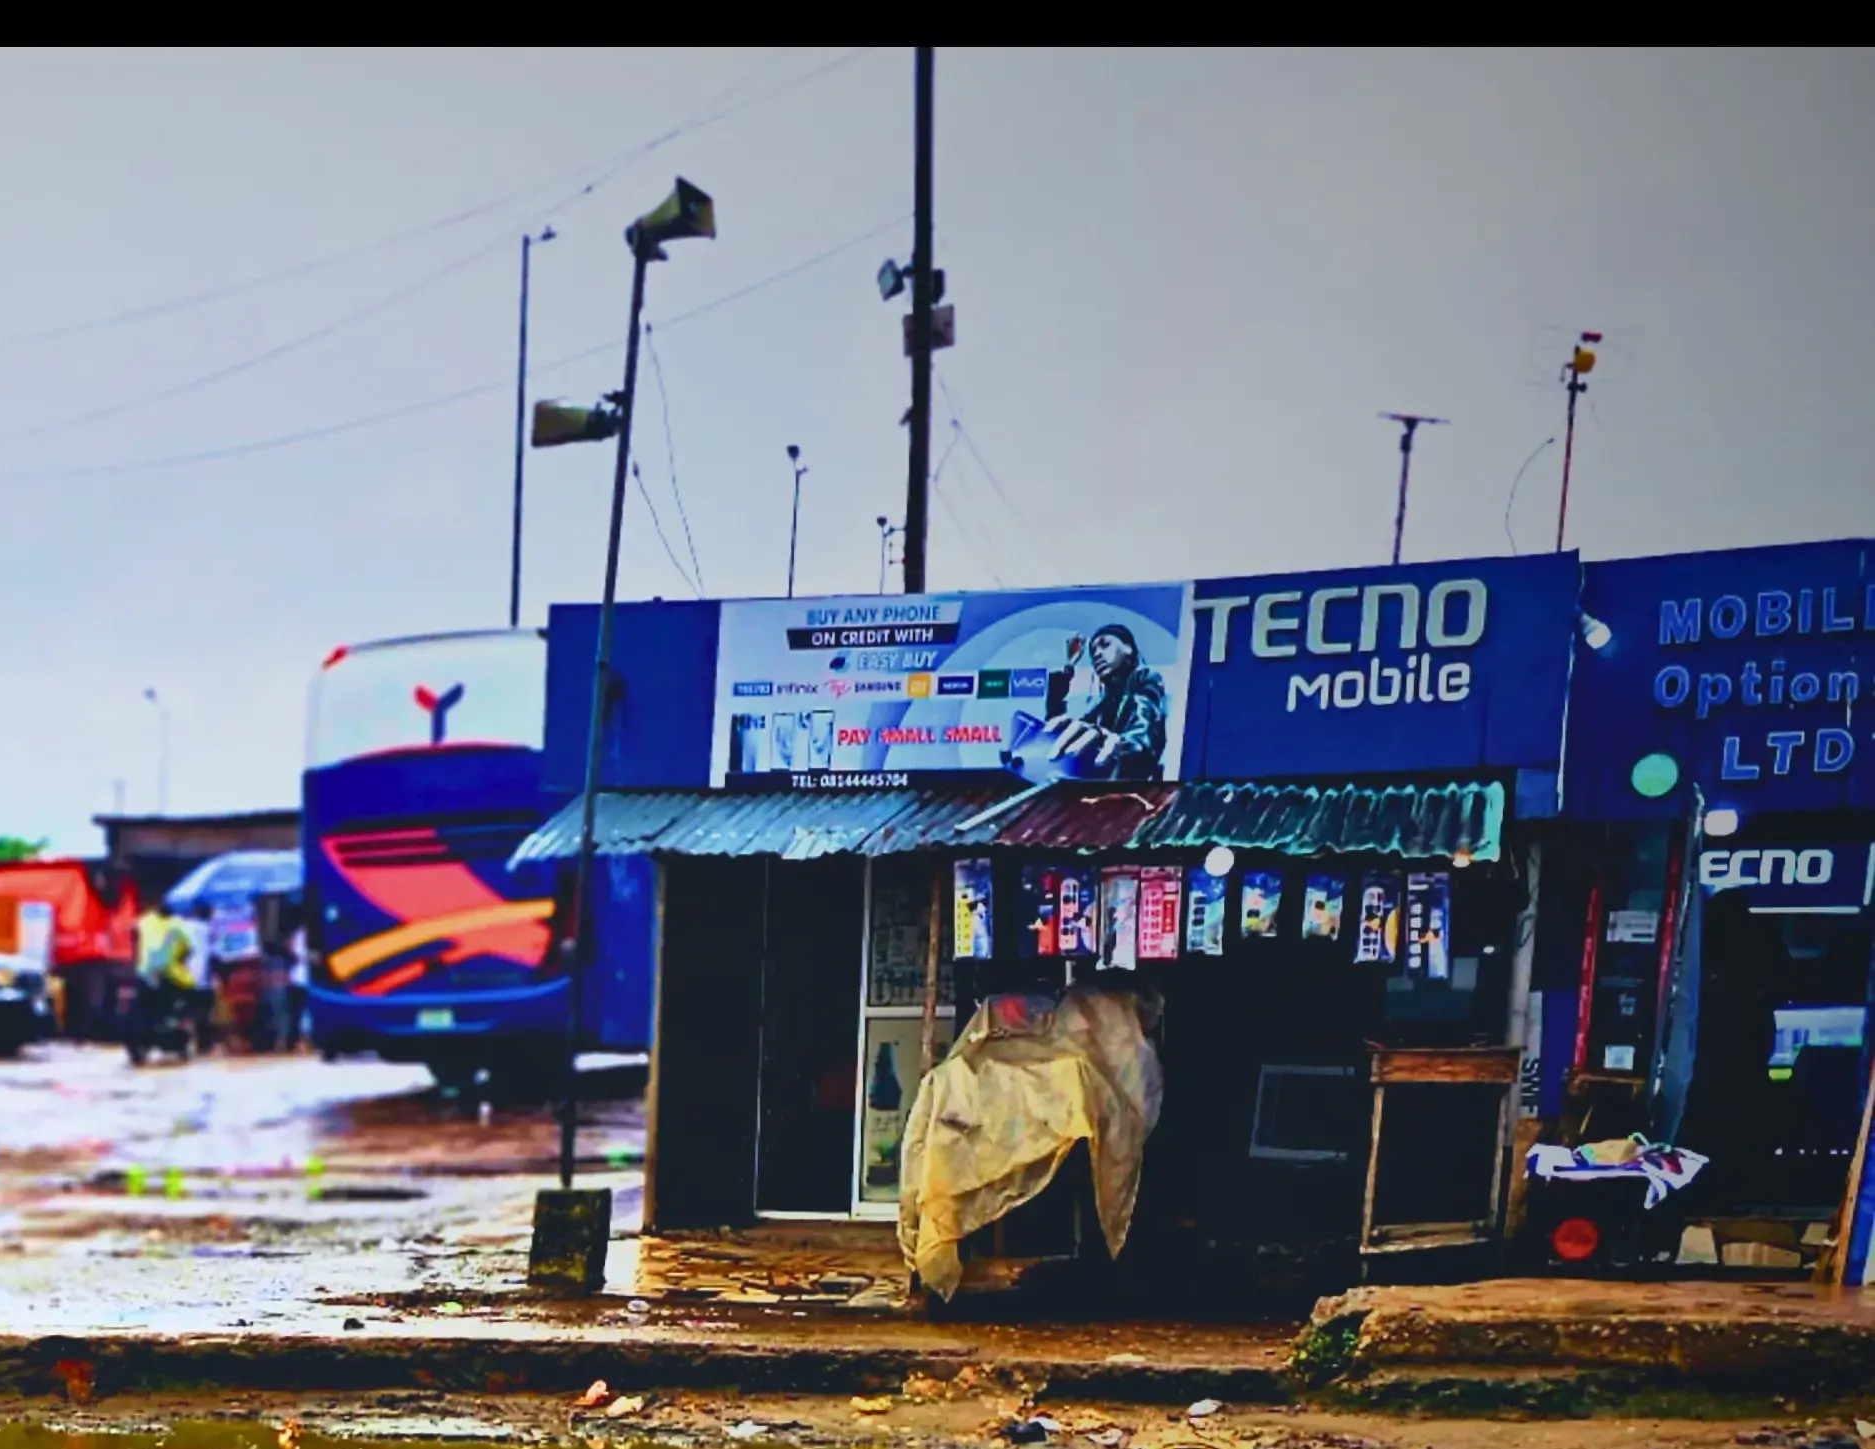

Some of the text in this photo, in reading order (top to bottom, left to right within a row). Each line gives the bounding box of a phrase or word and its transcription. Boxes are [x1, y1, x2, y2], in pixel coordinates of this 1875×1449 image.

[806, 605, 941, 626] BUY ANY PHONE
[1193, 578, 1487, 663] TECNO
[811, 628, 934, 646] ON CREDIT WITH
[858, 650, 938, 670] EASY BUY
[1653, 660, 1875, 720] Option
[838, 725, 1003, 745] PAY SMALL SMALL
[1721, 728, 1855, 780] LTD
[792, 775, 817, 788] TEL:
[1699, 849, 1834, 885] ECNO
